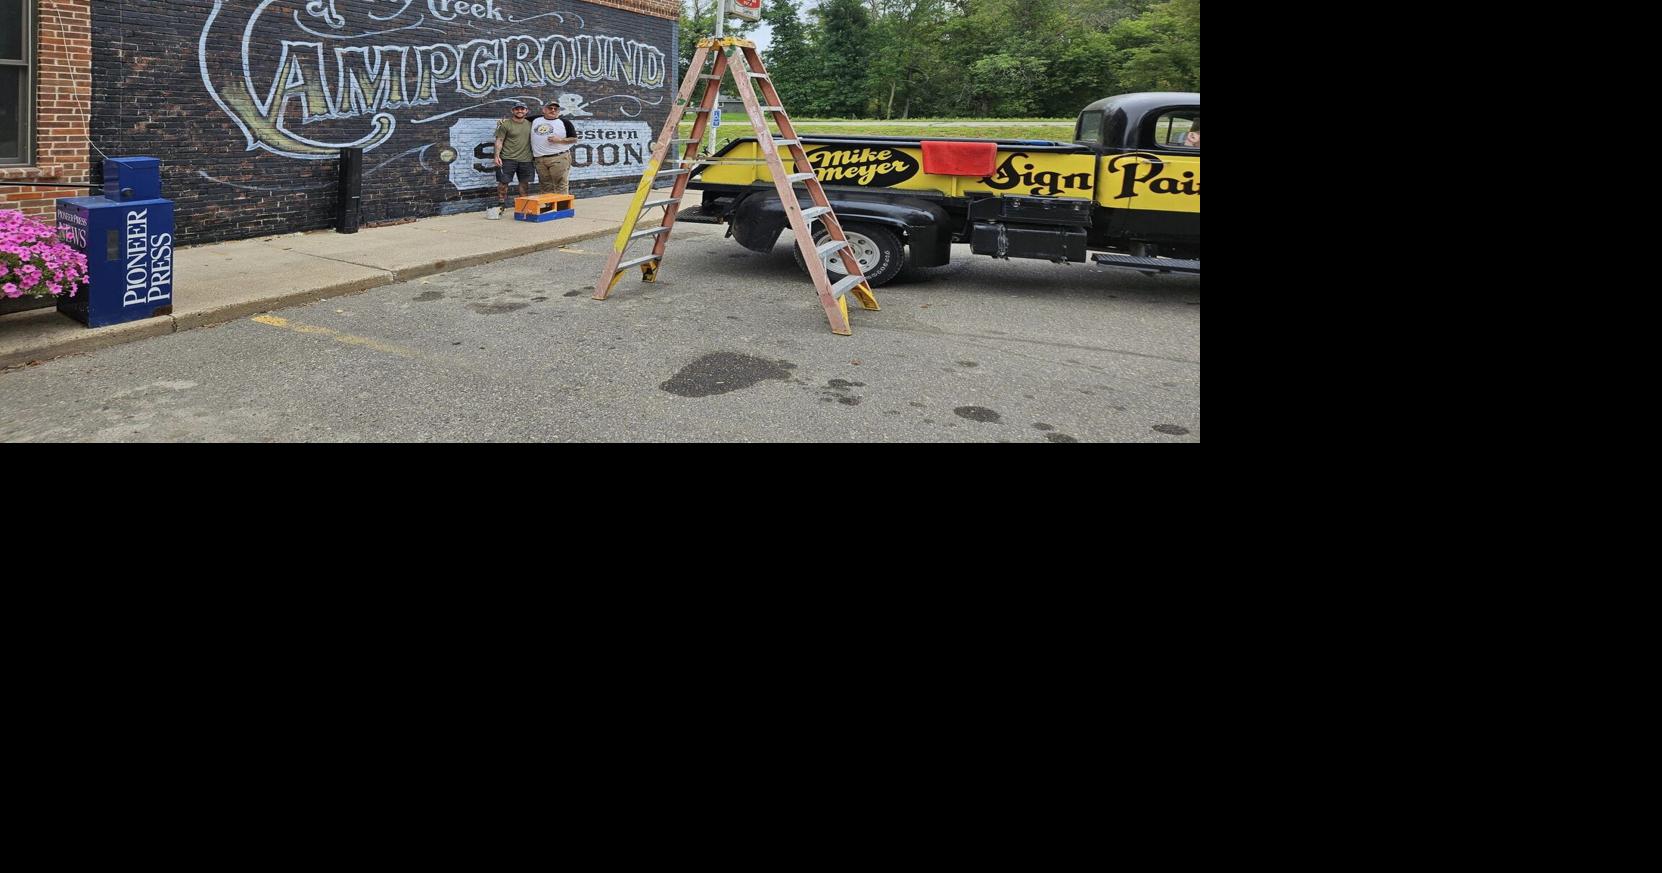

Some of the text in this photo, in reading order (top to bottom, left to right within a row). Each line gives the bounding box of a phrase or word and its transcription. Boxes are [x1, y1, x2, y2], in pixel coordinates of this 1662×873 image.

[199, 0, 666, 160] CAMPGROUND
[473, 142, 643, 174] SOON
[577, 129, 638, 140] estern
[807, 148, 892, 168] Mike
[977, 152, 1200, 200] Sign Pai
[123, 208, 148, 307] PIONEER
[147, 232, 172, 303] PRESS
